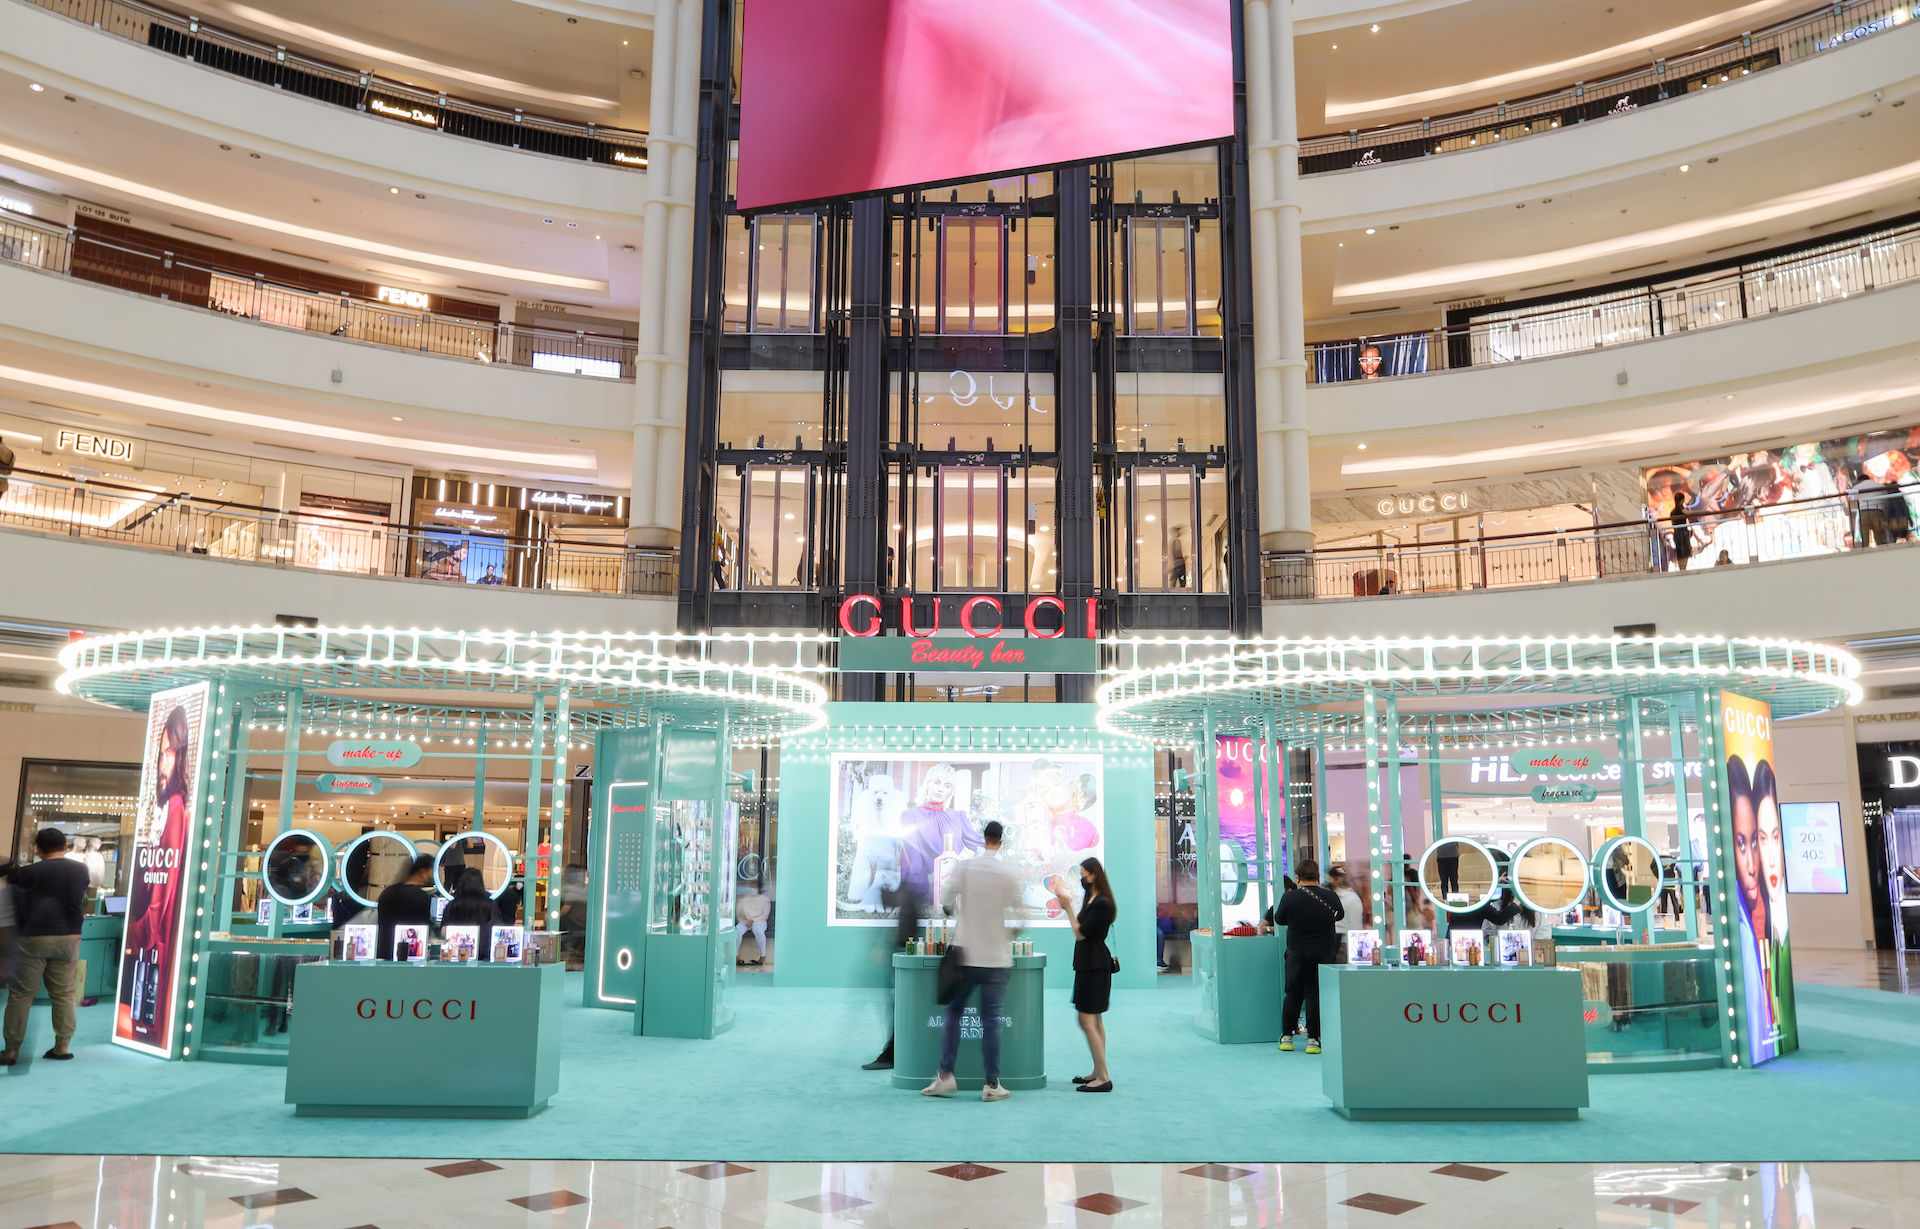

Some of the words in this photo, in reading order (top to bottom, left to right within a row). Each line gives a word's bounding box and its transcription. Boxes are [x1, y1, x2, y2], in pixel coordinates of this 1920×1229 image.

[378, 286, 429, 308] FENDI
[58, 430, 132, 461] FENDI
[1377, 492, 1468, 515] GUCCI
[839, 594, 1098, 639] GUCCI
[911, 640, 984, 669] Beauty
[990, 641, 1026, 664] bar
[1725, 706, 1770, 741] GUCCI
[342, 745, 403, 763] make-up
[1529, 753, 1590, 771] make-up
[1651, 761, 1703, 779] stre
[139, 847, 180, 869] GUCCI
[143, 871, 169, 885] GUILTY
[357, 998, 476, 1020] GUCCI
[1404, 1002, 1522, 1023] GUCCI
